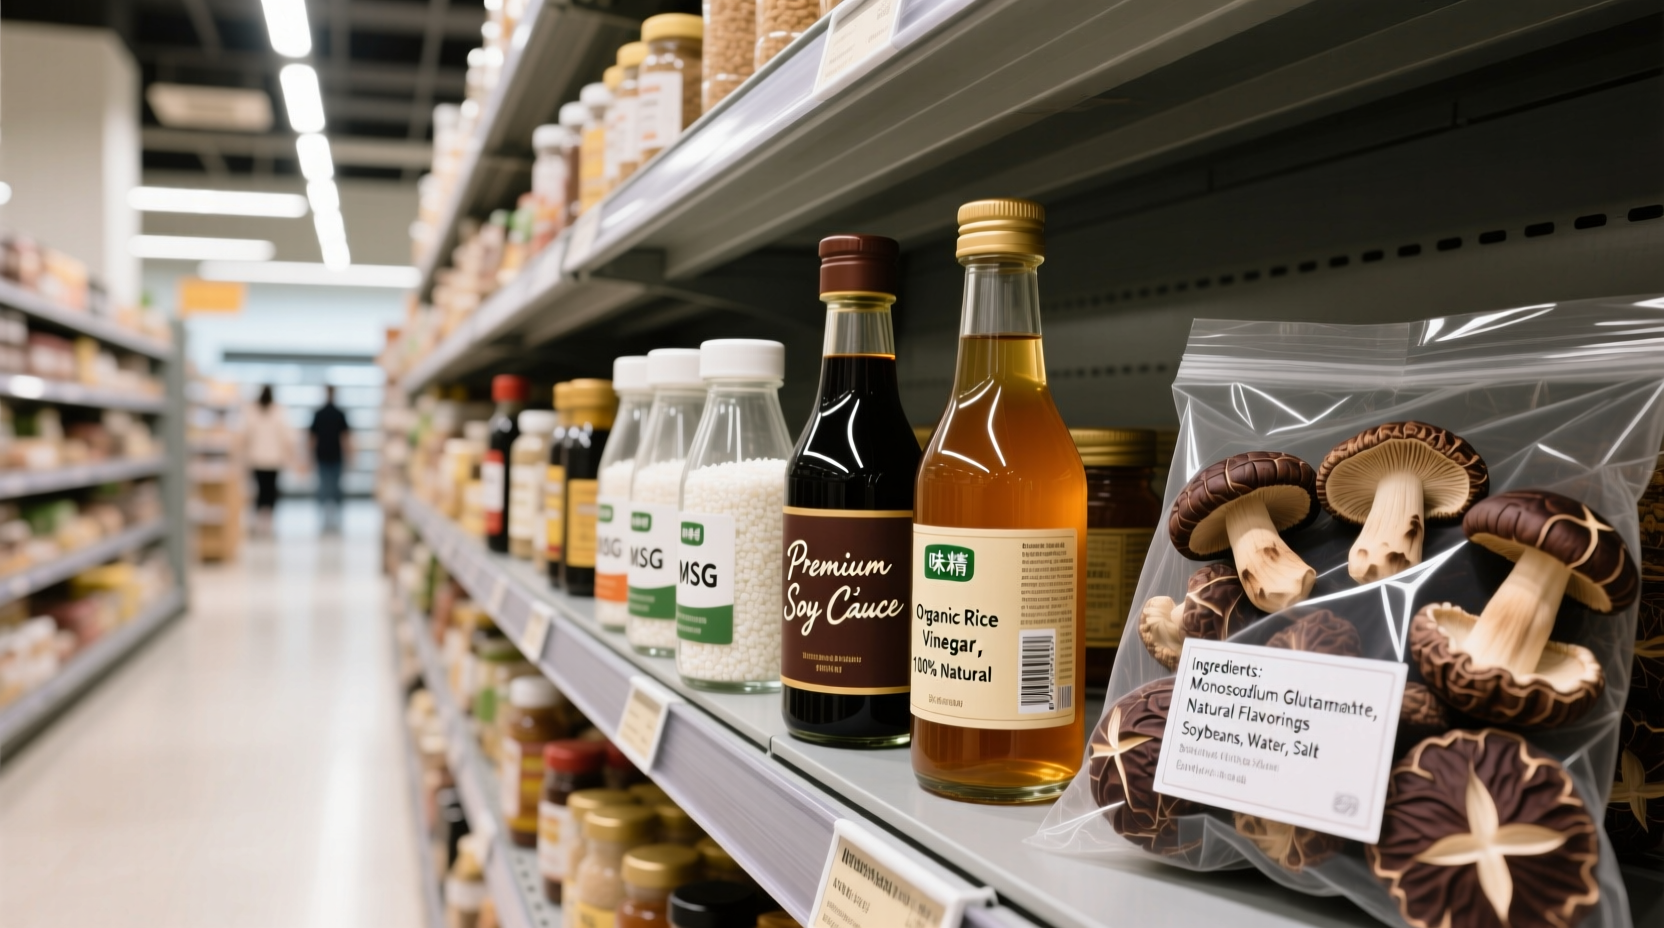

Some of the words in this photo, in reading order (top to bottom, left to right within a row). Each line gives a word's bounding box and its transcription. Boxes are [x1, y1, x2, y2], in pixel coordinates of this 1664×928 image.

[679, 559, 718, 588] MSG
[787, 539, 892, 581] Premium
[928, 549, 969, 577] 味精
[783, 582, 823, 636] Soy
[916, 603, 961, 627] Organic
[964, 608, 999, 628] Rice
[922, 629, 983, 658] Vinegar,
[913, 656, 938, 677] 100%
[940, 663, 992, 682] Natural
[1186, 697, 1235, 719] Natural
[1238, 705, 1310, 733] Flavorings
[1181, 720, 1244, 747] Soybeans,
[1247, 732, 1289, 757] Water,
[1293, 740, 1320, 759] Salt
